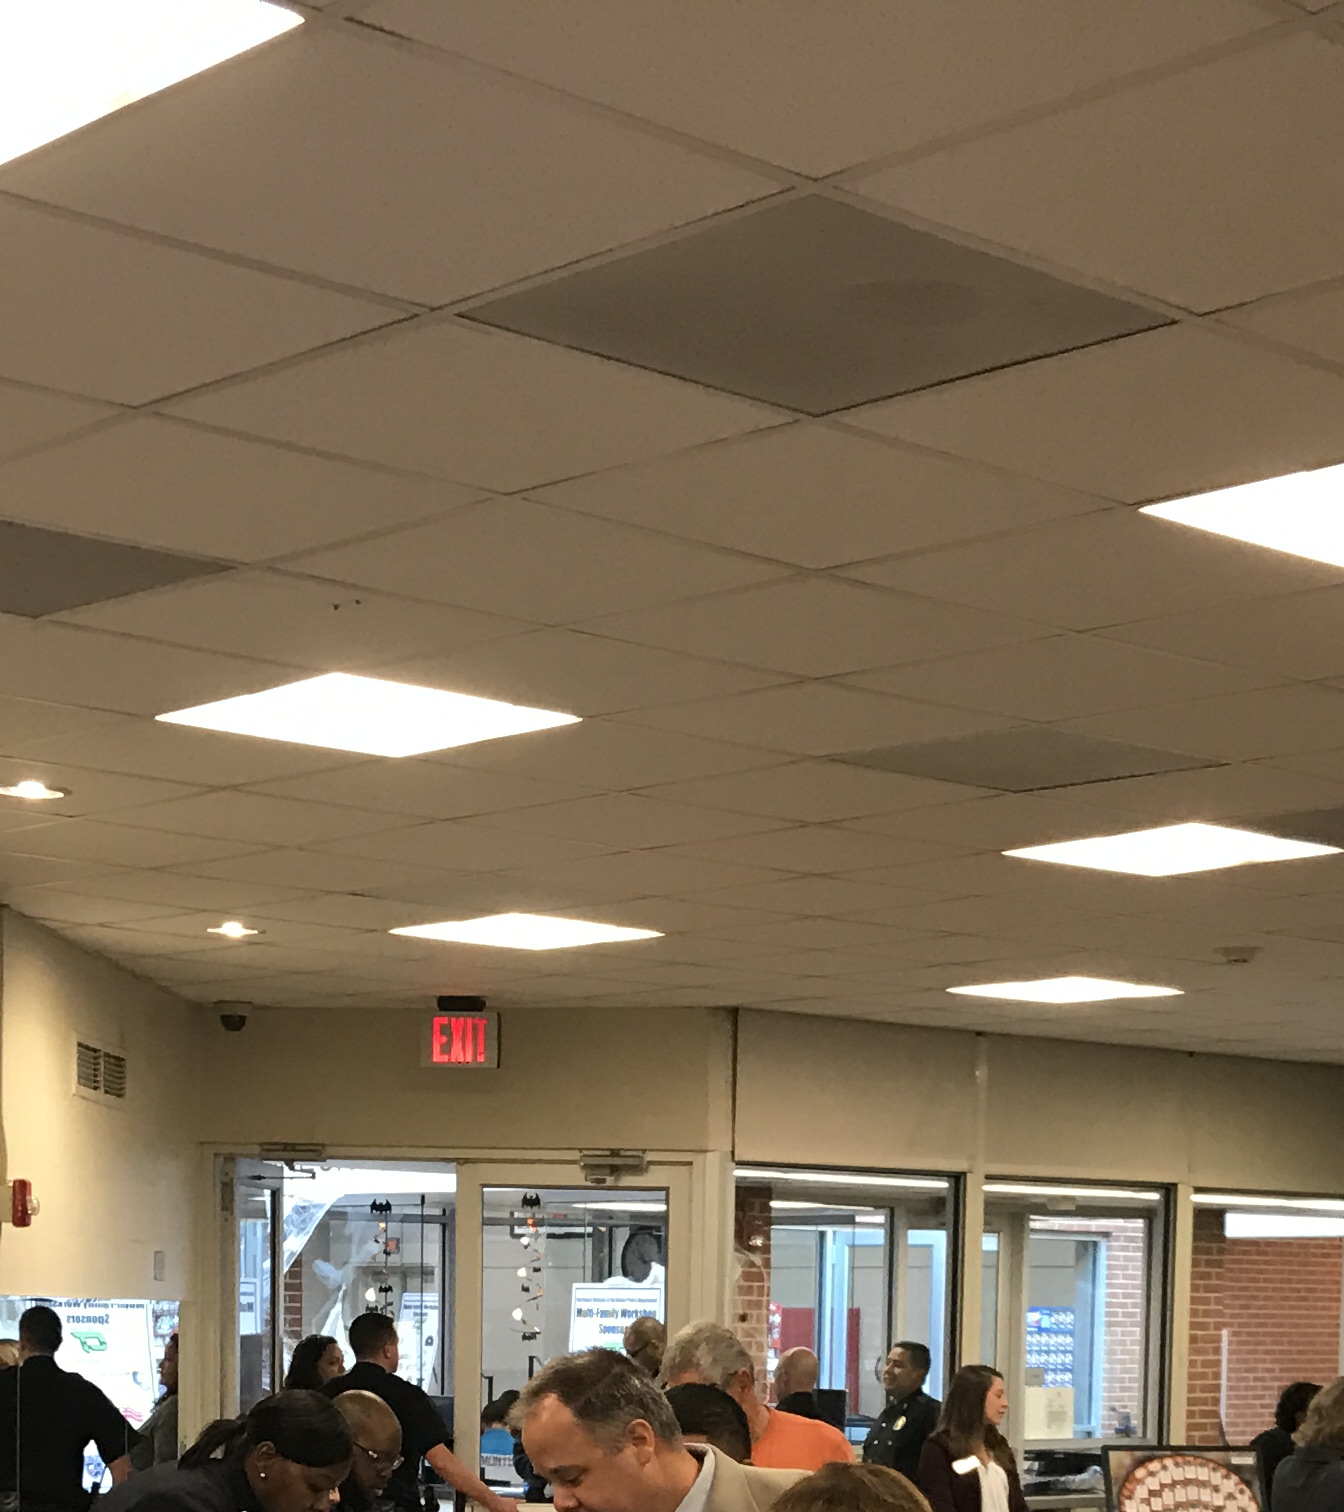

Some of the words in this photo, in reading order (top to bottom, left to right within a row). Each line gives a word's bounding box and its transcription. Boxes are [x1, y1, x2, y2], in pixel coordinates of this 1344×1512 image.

[432, 1016, 489, 1063] EXIT
[576, 1307, 619, 1319] Multi-Family
[598, 1323, 630, 1334] Sponso
